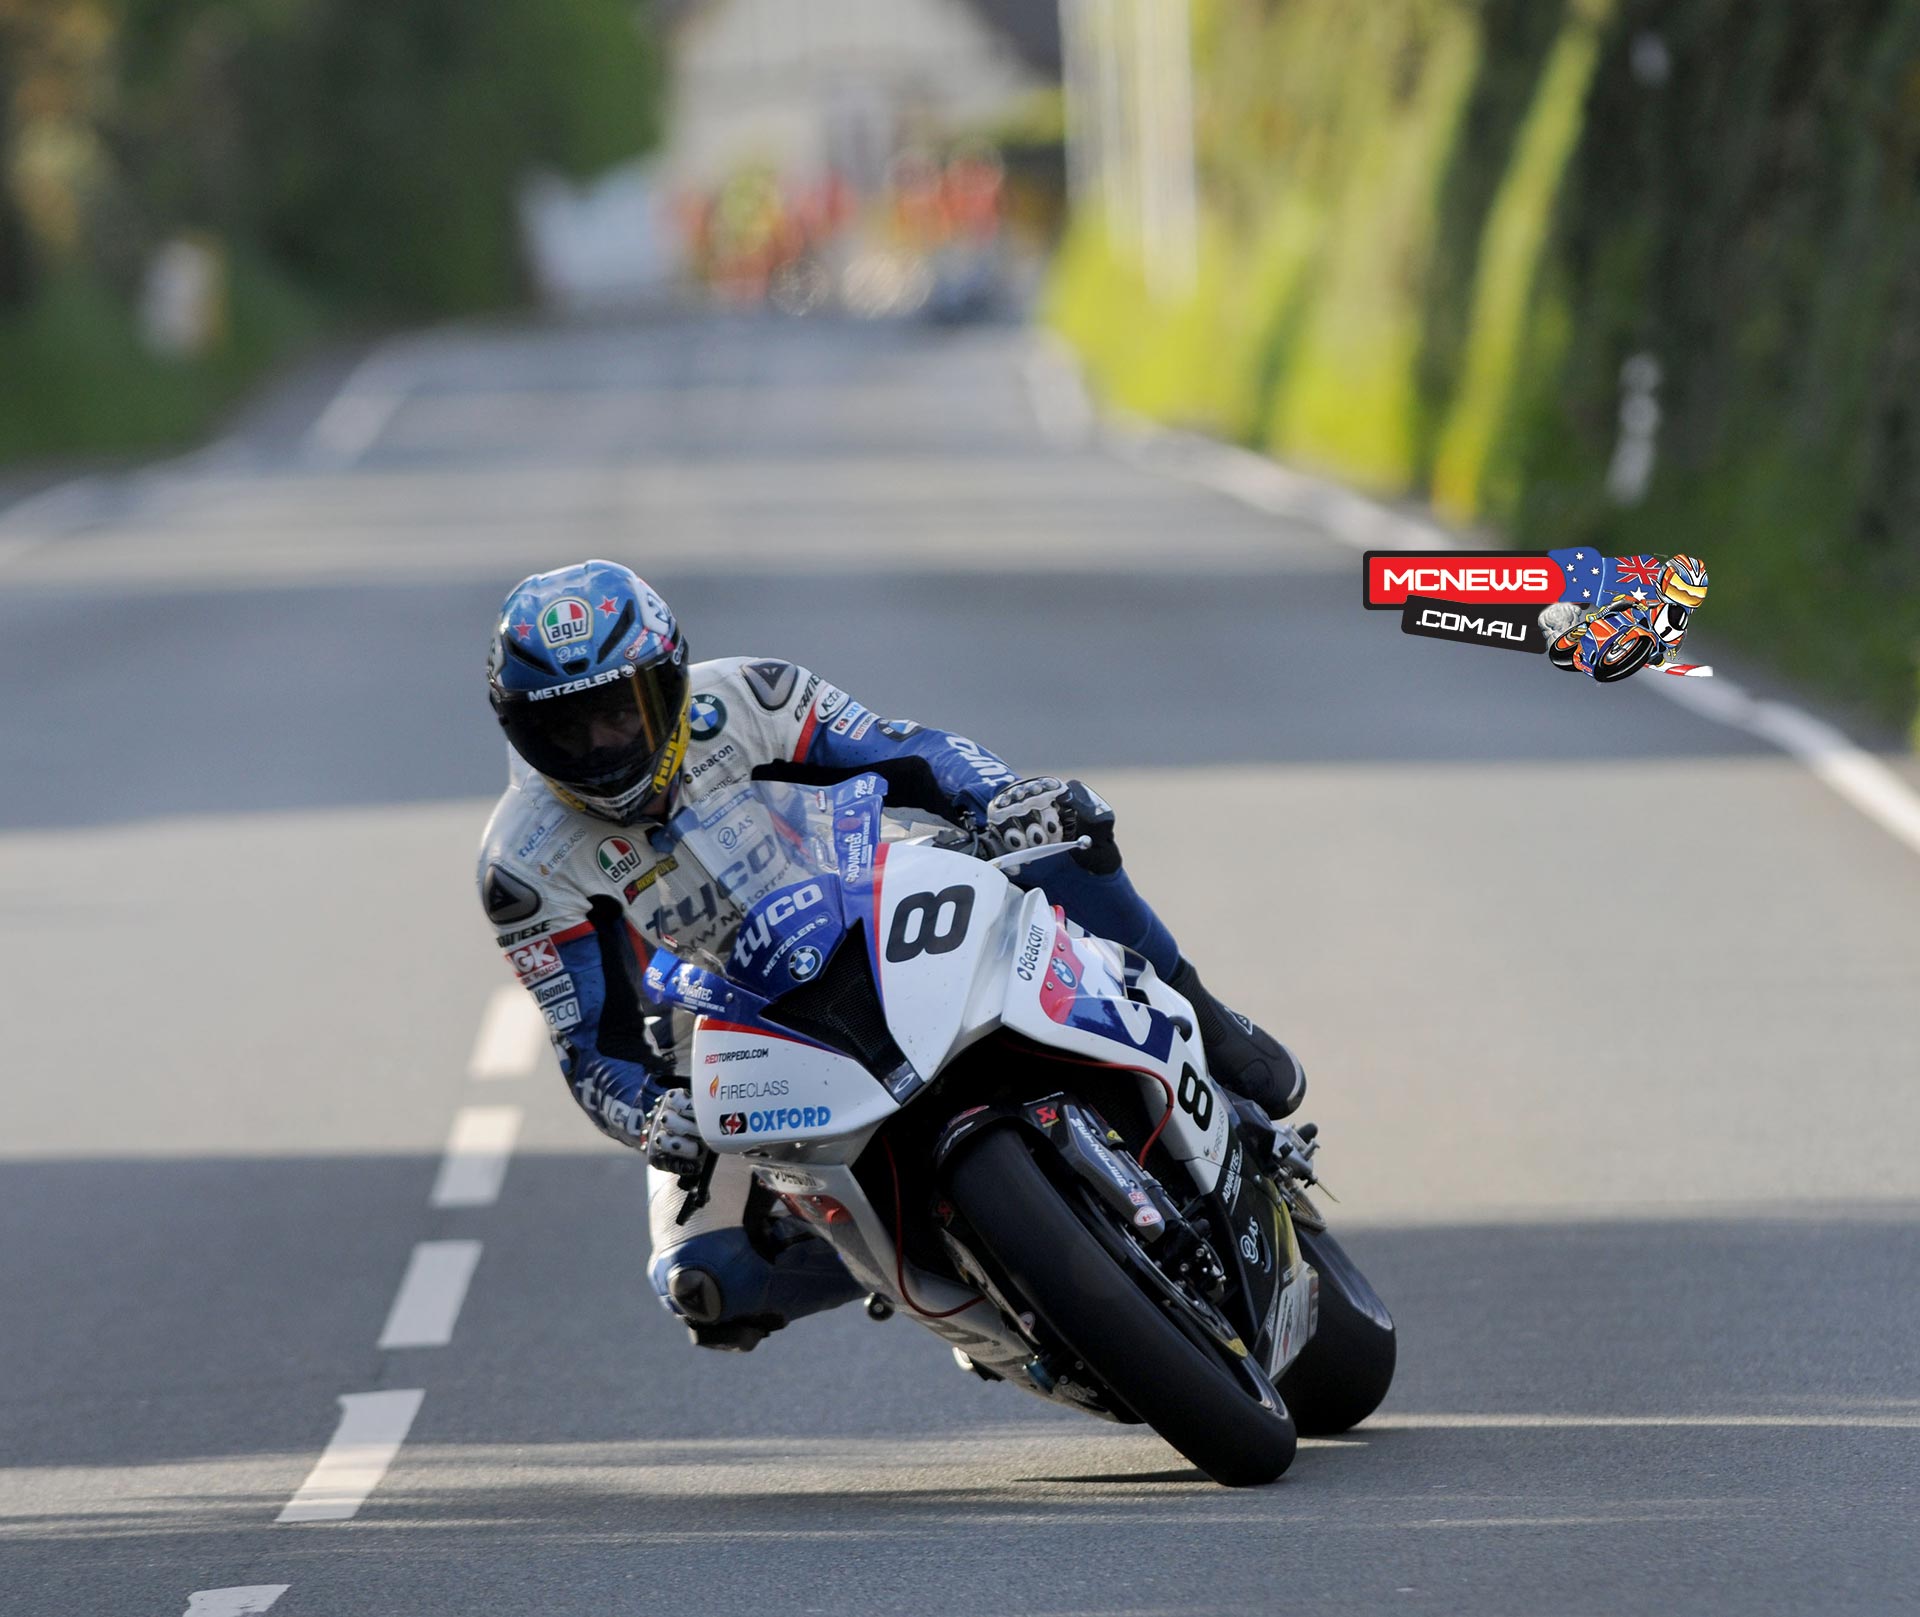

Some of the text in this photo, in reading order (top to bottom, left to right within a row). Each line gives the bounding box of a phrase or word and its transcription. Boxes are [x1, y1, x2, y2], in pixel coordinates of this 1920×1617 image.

[527, 668, 621, 702] METZELER
[691, 744, 734, 778] Beacon
[734, 883, 824, 968] tyco
[885, 884, 976, 964] 8
[763, 923, 817, 977] METZELER
[1019, 924, 1045, 971] Beacon
[534, 980, 572, 1002] Visonic
[704, 1047, 769, 1064] REDTORPEDO.COM
[720, 1080, 789, 1100] FIRECLASS
[1178, 1061, 1214, 1131] 8
[750, 1106, 831, 1132] OXFORD
